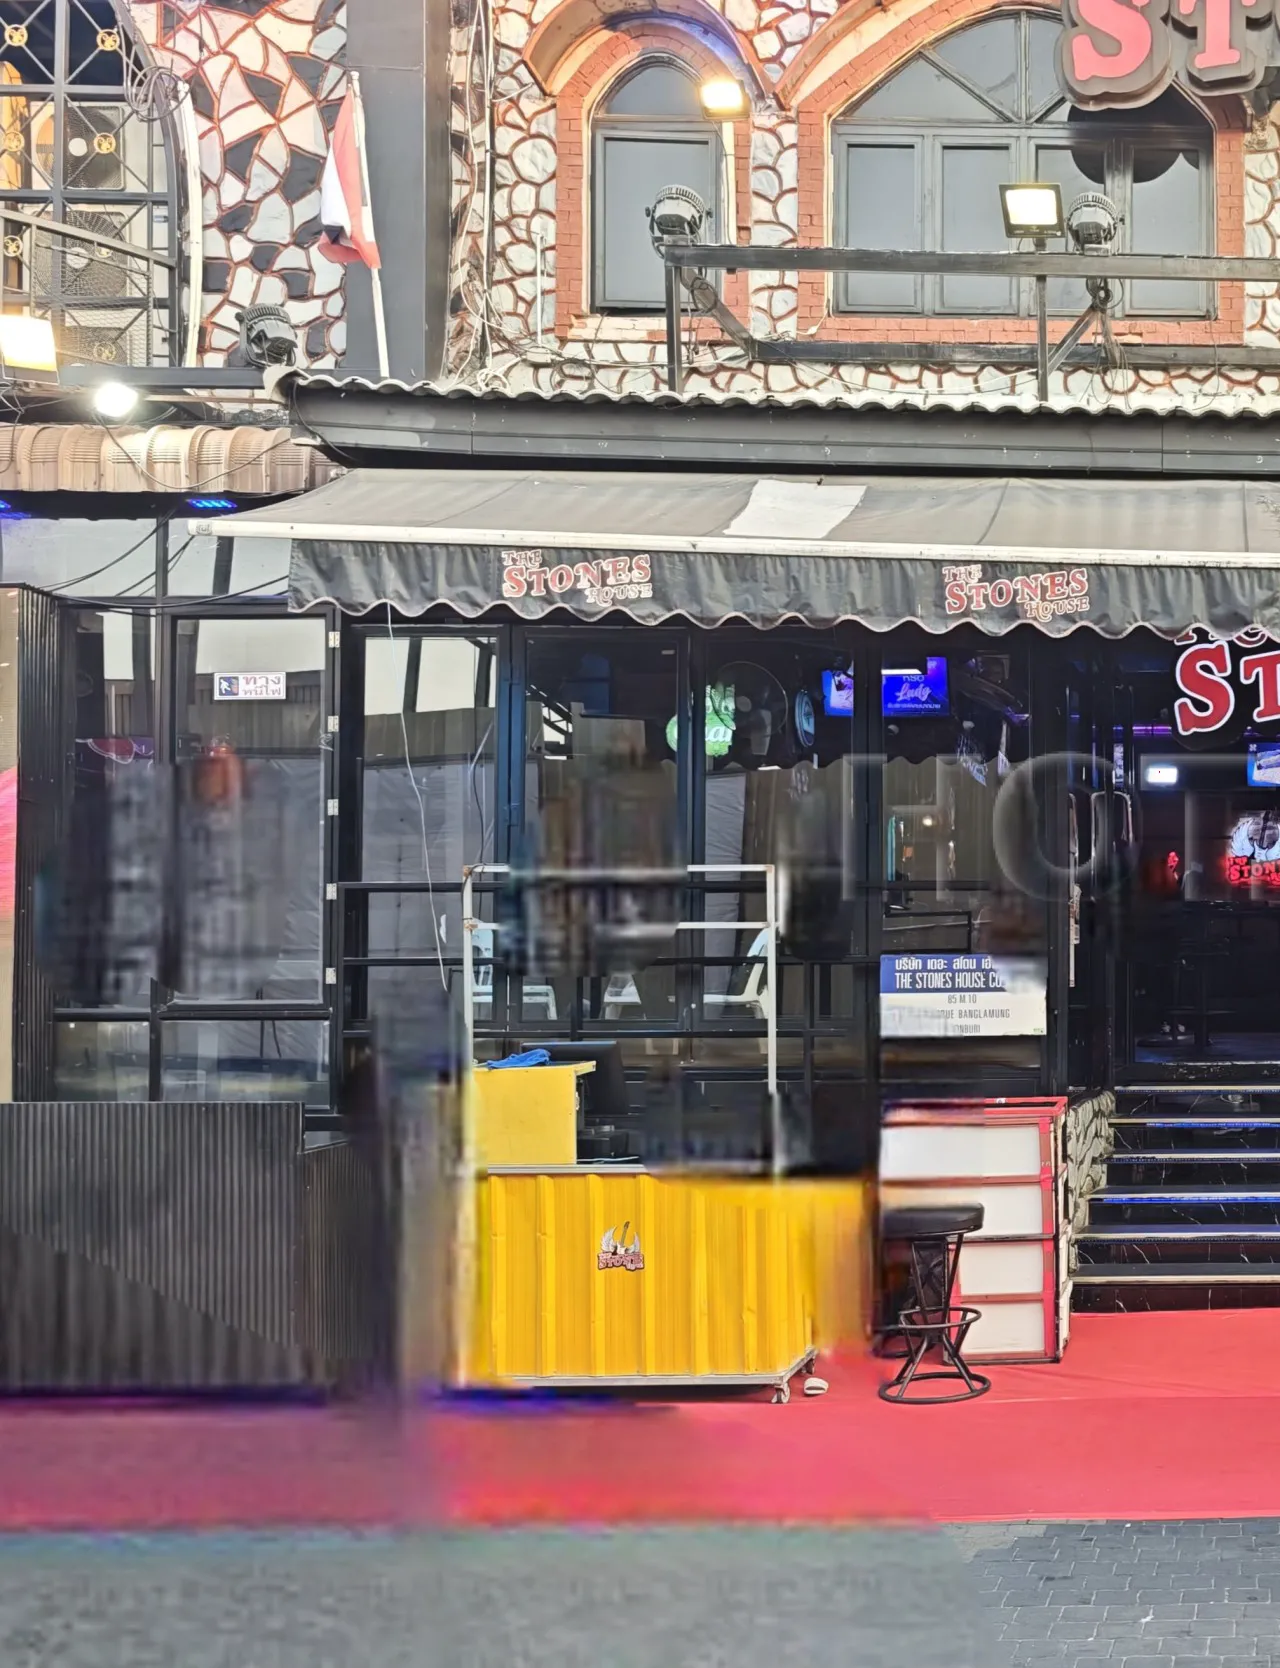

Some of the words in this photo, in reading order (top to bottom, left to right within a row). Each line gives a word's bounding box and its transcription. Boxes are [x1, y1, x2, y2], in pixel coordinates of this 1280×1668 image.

[502, 549, 542, 568] THE
[502, 554, 651, 598] STONES
[942, 564, 982, 583] THE
[585, 583, 652, 606] HOUSE
[946, 568, 1088, 614] STONES
[1025, 596, 1090, 622] HOUSE
[242, 676, 280, 685] ทาง
[895, 683, 932, 701] Lady
[895, 972, 912, 989] THE
[916, 972, 952, 989] STONES
[956, 972, 986, 988] HOUSE
[948, 994, 957, 1004] 85
[958, 1008, 1010, 1018] BANGLAMUNG
